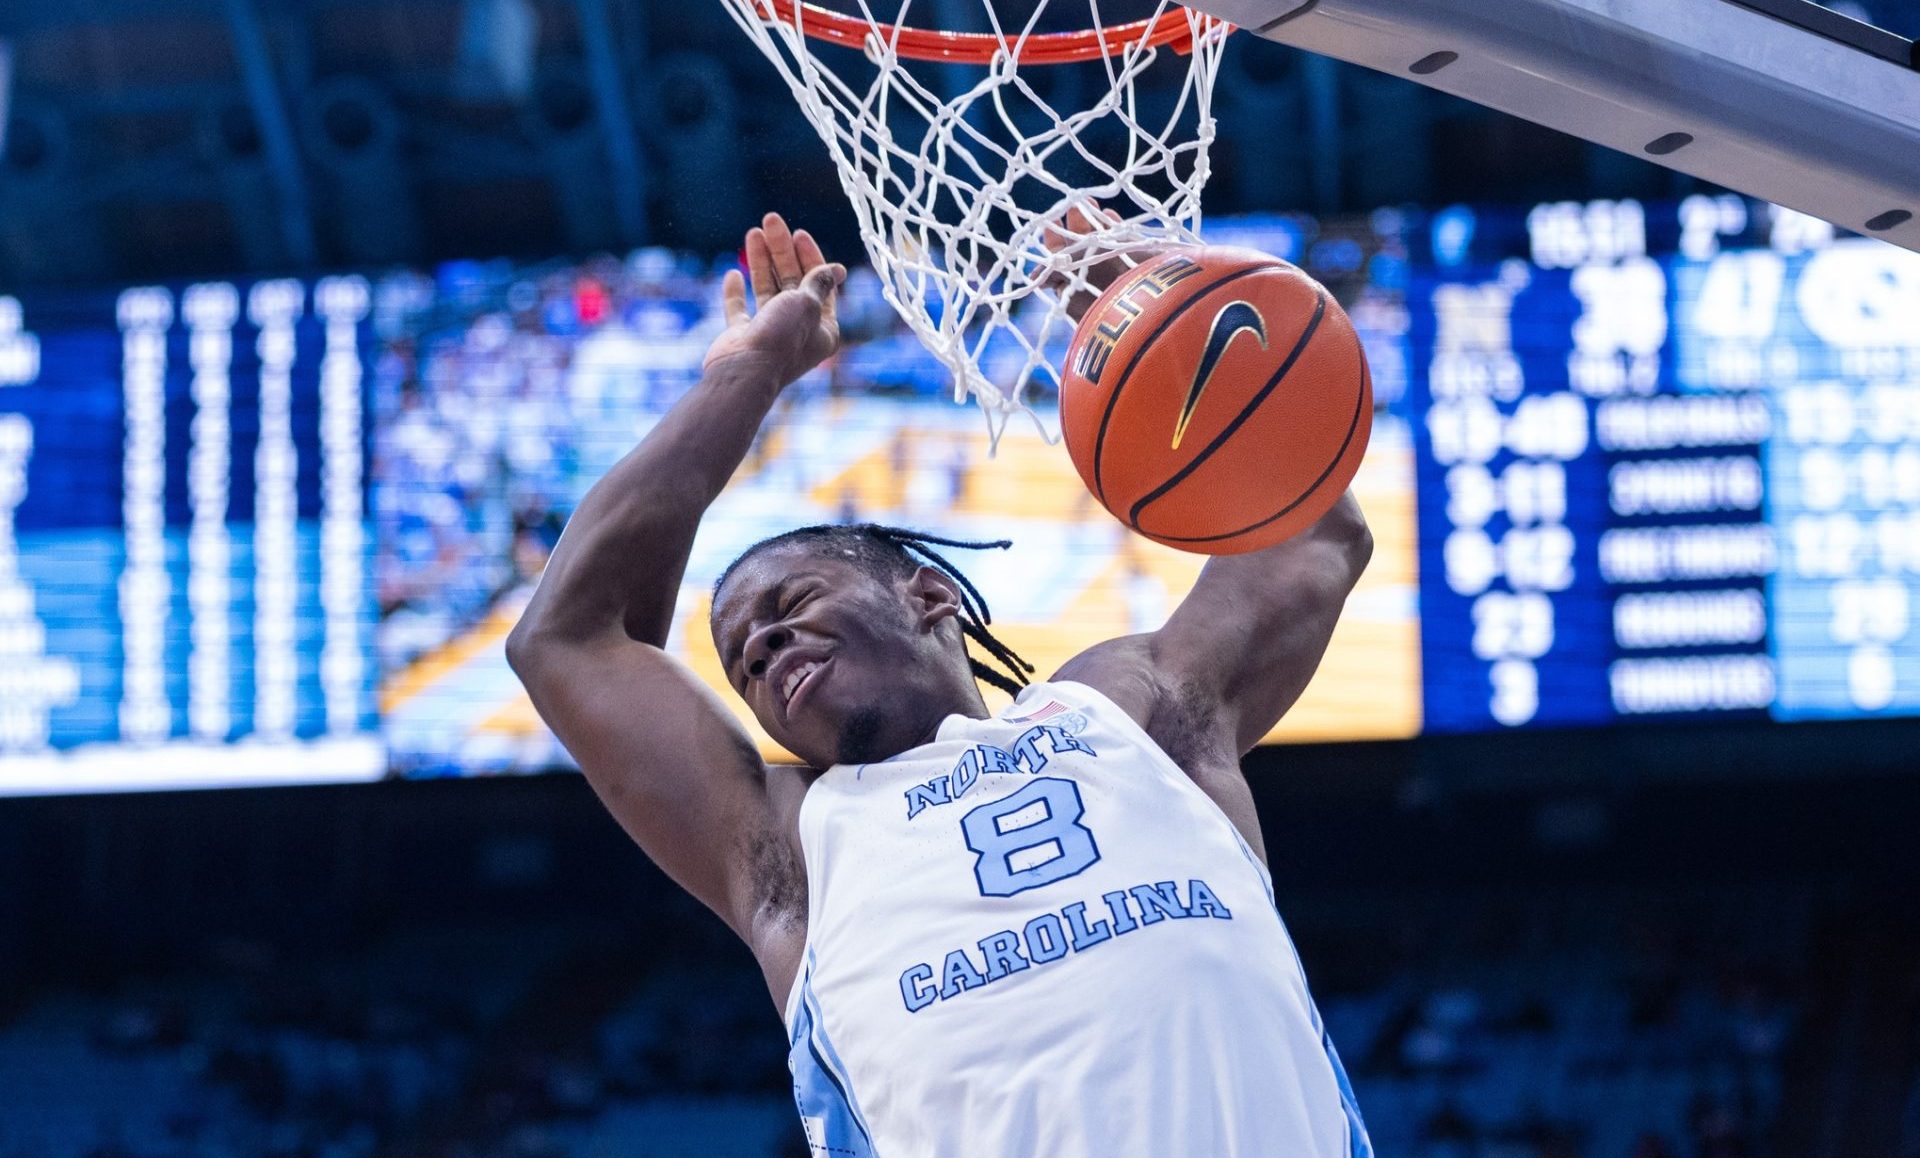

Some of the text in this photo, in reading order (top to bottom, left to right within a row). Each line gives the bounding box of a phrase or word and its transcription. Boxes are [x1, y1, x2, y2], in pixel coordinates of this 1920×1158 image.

[1073, 254, 1203, 386] ELITE
[904, 725, 1097, 820] NORTH
[960, 777, 1102, 898] 8
[899, 879, 1233, 1014] CAROLINA
